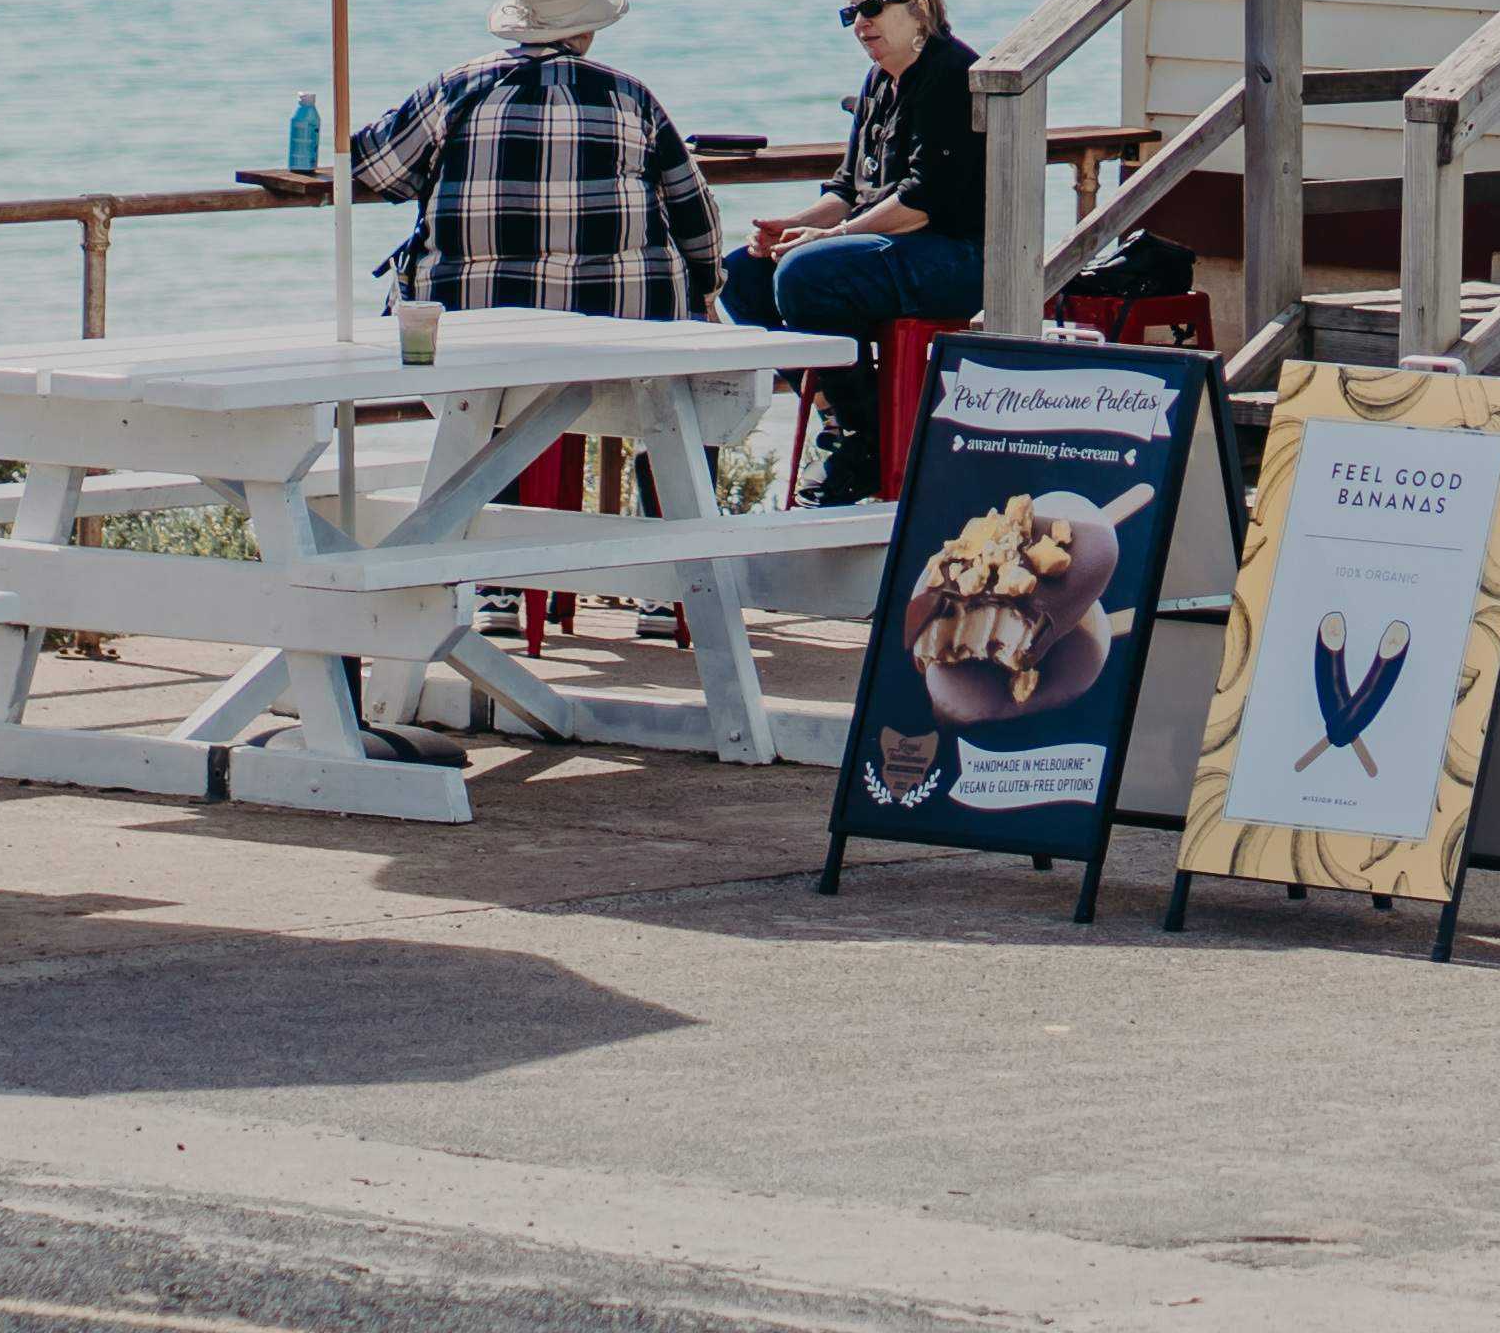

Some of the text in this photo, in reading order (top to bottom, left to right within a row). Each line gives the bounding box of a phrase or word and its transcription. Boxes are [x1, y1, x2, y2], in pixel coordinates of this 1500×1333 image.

[954, 384, 1161, 414] Port Melbourne Paletas
[966, 438, 1120, 463] award winning ice-cream
[1331, 462, 1464, 491] FEEL GOOD
[1337, 487, 1446, 515] BANANAS
[1335, 565, 1422, 585] 100% ORGANIC
[972, 757, 1085, 773] HANDMADE IN MELBOURNE
[958, 776, 1094, 795] VEGAN & GLUTEN-FREE OPTIONS
